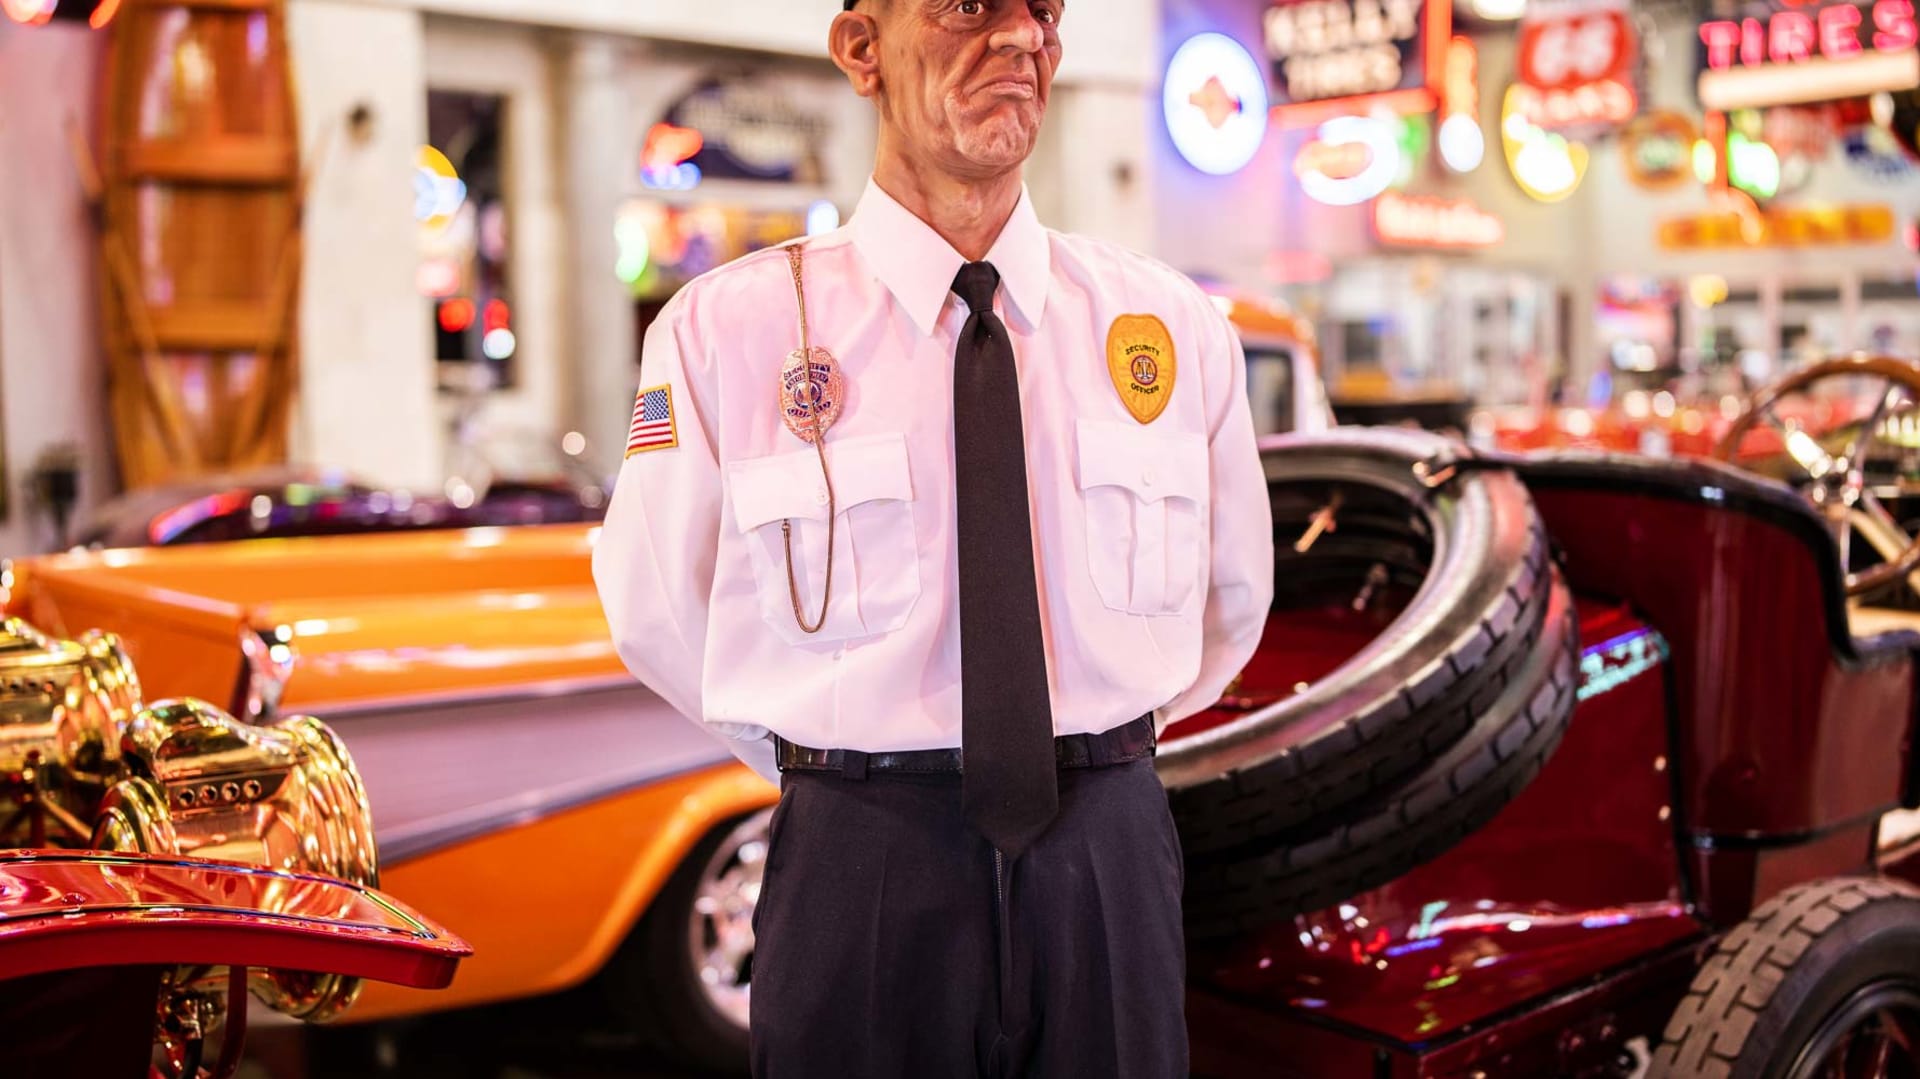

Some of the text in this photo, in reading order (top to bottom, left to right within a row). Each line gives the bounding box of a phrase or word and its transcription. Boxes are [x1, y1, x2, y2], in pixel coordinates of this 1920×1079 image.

[1699, 0, 1918, 71] TIRES
[1126, 344, 1160, 356] SECURITY
[1131, 383, 1159, 395] OFFICER
